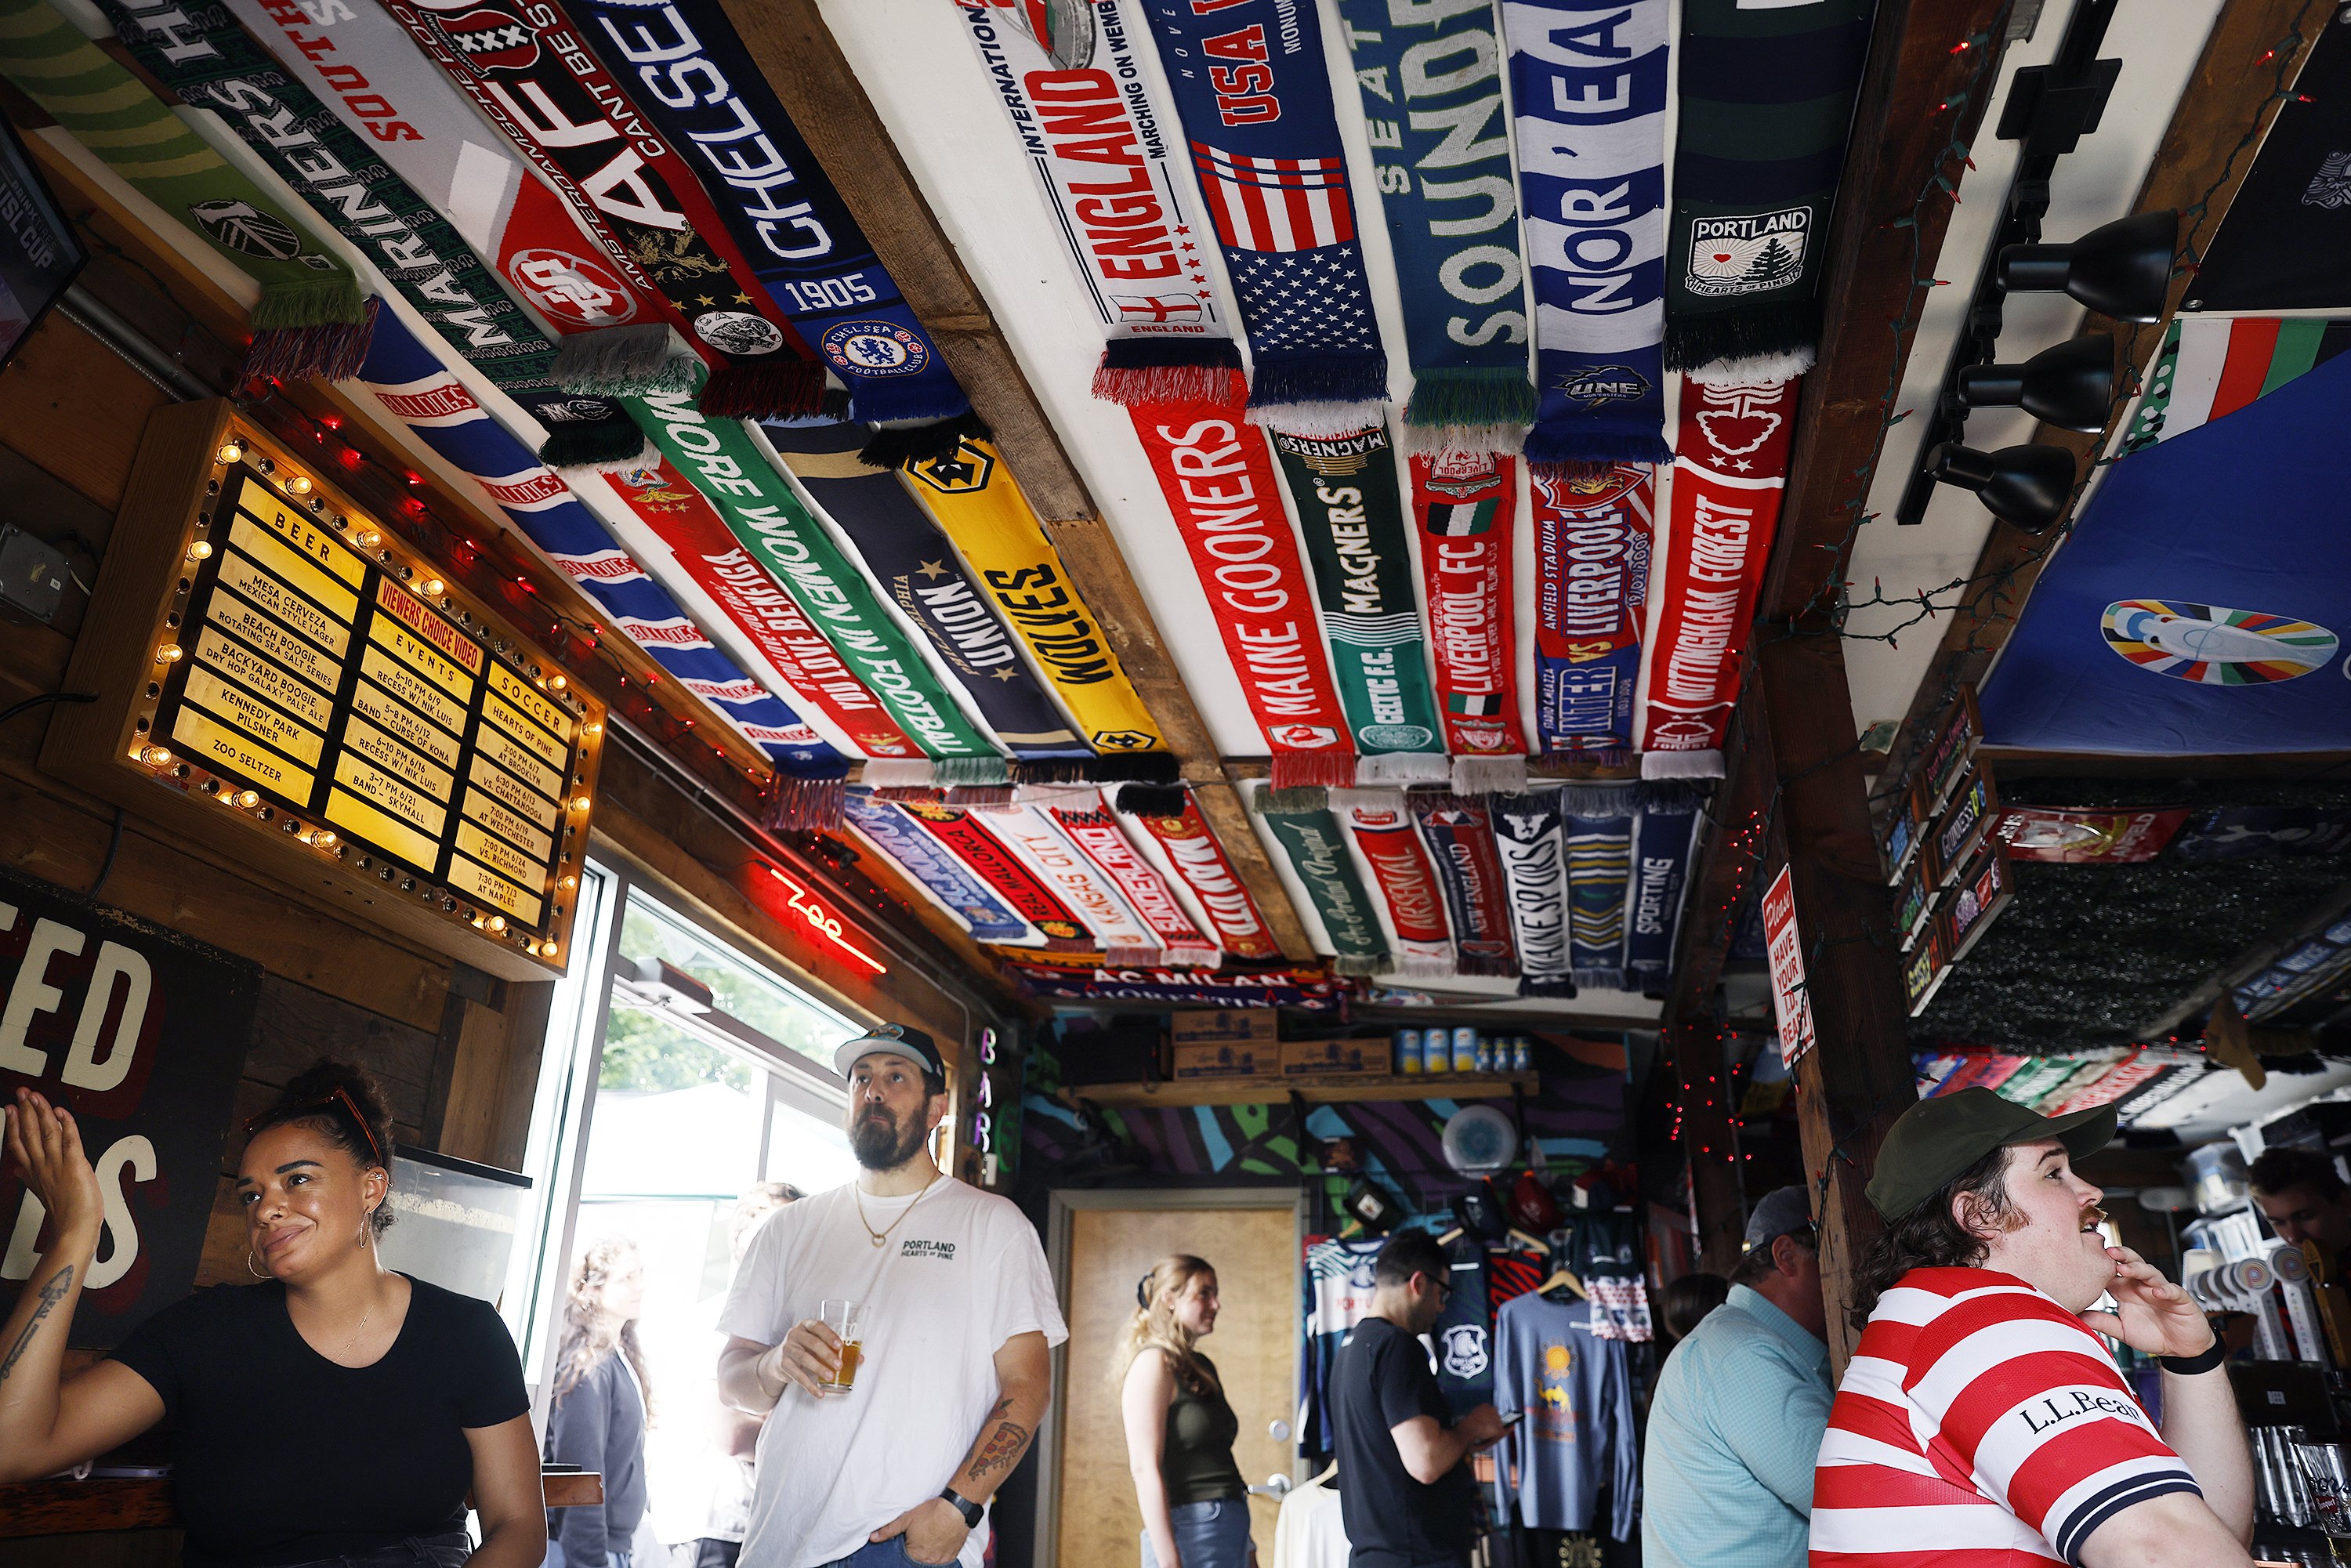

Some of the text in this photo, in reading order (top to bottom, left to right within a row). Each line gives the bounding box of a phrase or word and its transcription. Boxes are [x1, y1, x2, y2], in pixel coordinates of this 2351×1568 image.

[257, 0, 426, 141] SOUTH
[1114, 56, 1138, 79] ON
[1201, 24, 1282, 127] USA
[547, 31, 666, 158] CANT BE
[599, 0, 833, 259] CHELSE
[1125, 82, 1167, 159] MARCHING
[451, 68, 653, 291] AMSTERDAMSCHE
[1023, 68, 1183, 281] ENGLAND
[207, 79, 514, 349] MARINERS
[1697, 212, 1806, 239] PORTLAND
[20, 225, 53, 269] CUP
[784, 273, 876, 312] 1905
[1696, 284, 1743, 295] HEARTS
[1759, 277, 1790, 289] PINE
[831, 325, 892, 342] CHELSEA
[1131, 324, 1205, 335] ENGLAND
[847, 364, 906, 376] FOOTBALL
[1569, 382, 1641, 396] UNE
[642, 390, 764, 498] MORE
[1291, 433, 1386, 458] MAGNERS
[1439, 464, 1488, 476] LIVERPOOL
[274, 512, 330, 562] BEER
[1317, 486, 1384, 614] MAGNERS
[561, 558, 638, 578] BULLDOGS
[734, 505, 862, 621] WOMEN
[1156, 419, 1322, 715] MAINE GOONERS
[1541, 520, 1558, 630] ANFIELD STADIUM
[1566, 509, 1625, 636] LIVERPOOL
[1627, 531, 1649, 609] 19/02/2008
[238, 579, 335, 646] MEXICAN STYLE LAGER
[252, 575, 326, 631] MESA CERVEZA
[1438, 541, 1494, 693] LIVERPOOL FC
[1487, 564, 1498, 645] NEVER WALK ALONE
[1665, 493, 1754, 701] NOTTINGHAM FOREST
[219, 611, 332, 686] ROTATING SEA SALT SERIES
[242, 613, 317, 665] BEACH BOOGIE
[382, 581, 479, 669] VIEWERS CHOICE VIDEO
[629, 625, 698, 643] BULLDOGS
[701, 547, 878, 711] YOU LOVE BENFICA
[831, 625, 889, 652] IN
[893, 574, 981, 676] PHILADELPHIA
[915, 581, 1016, 668] UNION
[984, 563, 1114, 686] WOLVES
[221, 643, 317, 708] BACKYARD BOOGIE
[396, 634, 455, 681] EVENTS
[755, 632, 809, 680] YOU LOVE
[1567, 640, 1614, 664] VS
[206, 647, 324, 723] DRY HOP GALAXY PALE ALE
[377, 670, 453, 726] RECESS NIK LUIS
[395, 672, 441, 706] 6-10 6/9
[502, 677, 560, 731] SOCCER
[857, 656, 973, 755] FOOTBALL
[1371, 674, 1405, 725] CELTIC
[1558, 665, 1617, 734] INTER
[220, 689, 300, 741] KENNEDY PARK
[236, 712, 279, 743] PILSNER
[357, 699, 450, 763] BAND CURSE KONA
[384, 704, 431, 739] 5-8 6/12
[493, 705, 552, 757] HEARTS PINE
[1541, 705, 1555, 730] STADIO
[212, 739, 282, 782] ZOO SELTZER
[359, 737, 437, 792] RECESS NIK LUIS
[376, 737, 426, 773] 6-10 6/16
[503, 744, 540, 774] 3:00 6/7
[1652, 741, 1708, 750] FOREST
[369, 773, 416, 806] 3-7 6/21
[495, 774, 536, 806] 6:30 6/13
[509, 759, 541, 786] BROOKLYN
[353, 776, 425, 824] BAND SKYMALL
[484, 777, 542, 821] VS. CHATTANOOGA
[490, 806, 529, 835] 7:00 6/19
[484, 838, 526, 867] 7:00 6/24
[490, 817, 534, 850] WESTCHESTER
[478, 872, 517, 898] 7:30 7/3
[480, 846, 527, 878] VS. RICHMOND
[946, 829, 1027, 891] MALLORCA
[1014, 832, 1125, 925] KANSAS CITY
[1077, 826, 1185, 933] SUNDERLAND
[1162, 835, 1261, 936] MAN UTD
[1448, 842, 1484, 905] ENGLAND
[488, 889, 515, 909] NAPLES
[1019, 891, 1052, 917] REAL
[1371, 846, 1438, 930] ARSENAL
[1508, 838, 1565, 972] MAINE SPURS
[1635, 856, 1675, 935] SPORTING
[1465, 907, 1489, 933] NEW
[1766, 890, 1791, 938] Please
[1773, 930, 1795, 970] HAVE
[1776, 957, 1799, 994] YOUR
[1093, 969, 1290, 990] AC MILAN
[973, 1026, 998, 1154] BAR
[903, 1240, 956, 1253] PORTLAND
[2020, 1390, 2141, 1436] L.L.Bean
